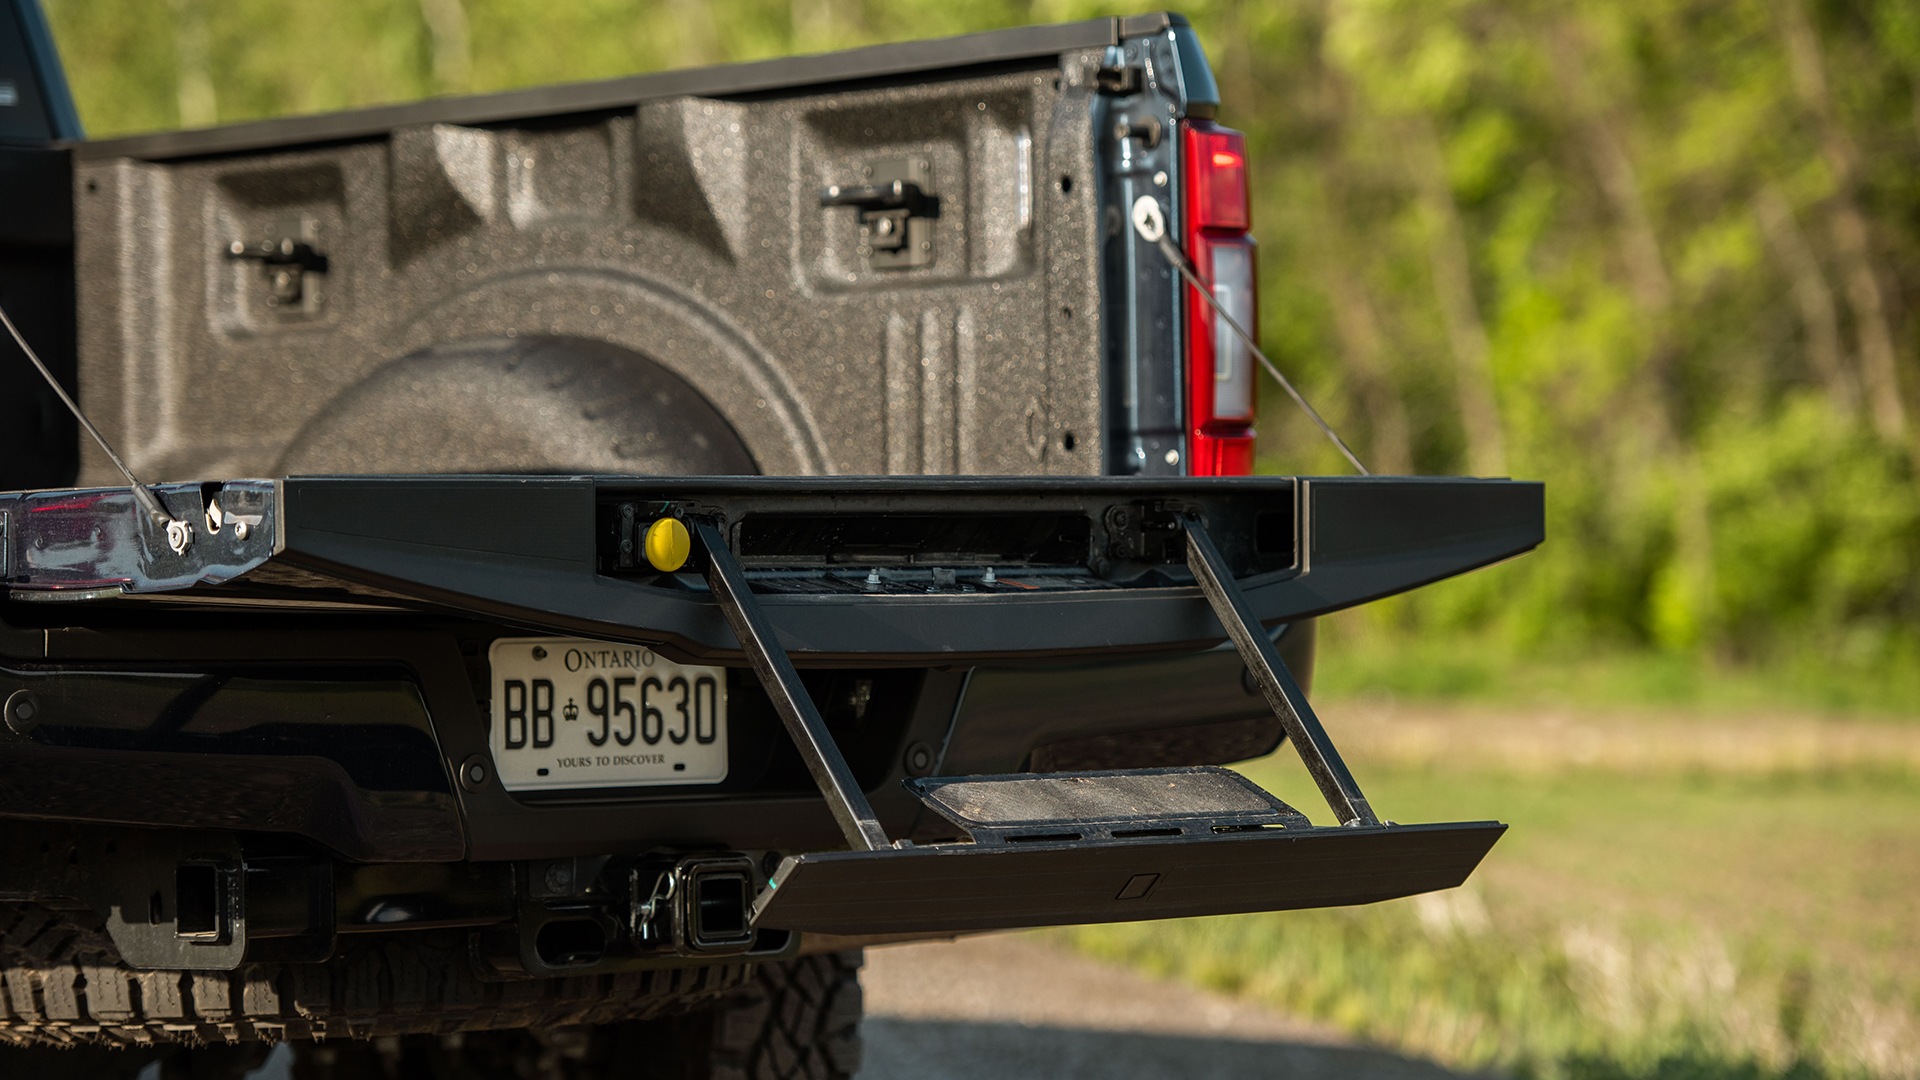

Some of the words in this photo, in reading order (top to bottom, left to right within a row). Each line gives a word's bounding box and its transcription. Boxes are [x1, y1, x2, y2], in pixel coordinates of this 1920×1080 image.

[564, 649, 655, 672] ONTARIO
[505, 679, 554, 750] BB
[587, 677, 717, 747] 95630
[557, 757, 592, 768] YOURS
[596, 756, 610, 766] TO
[613, 754, 665, 766] DISCOVER
